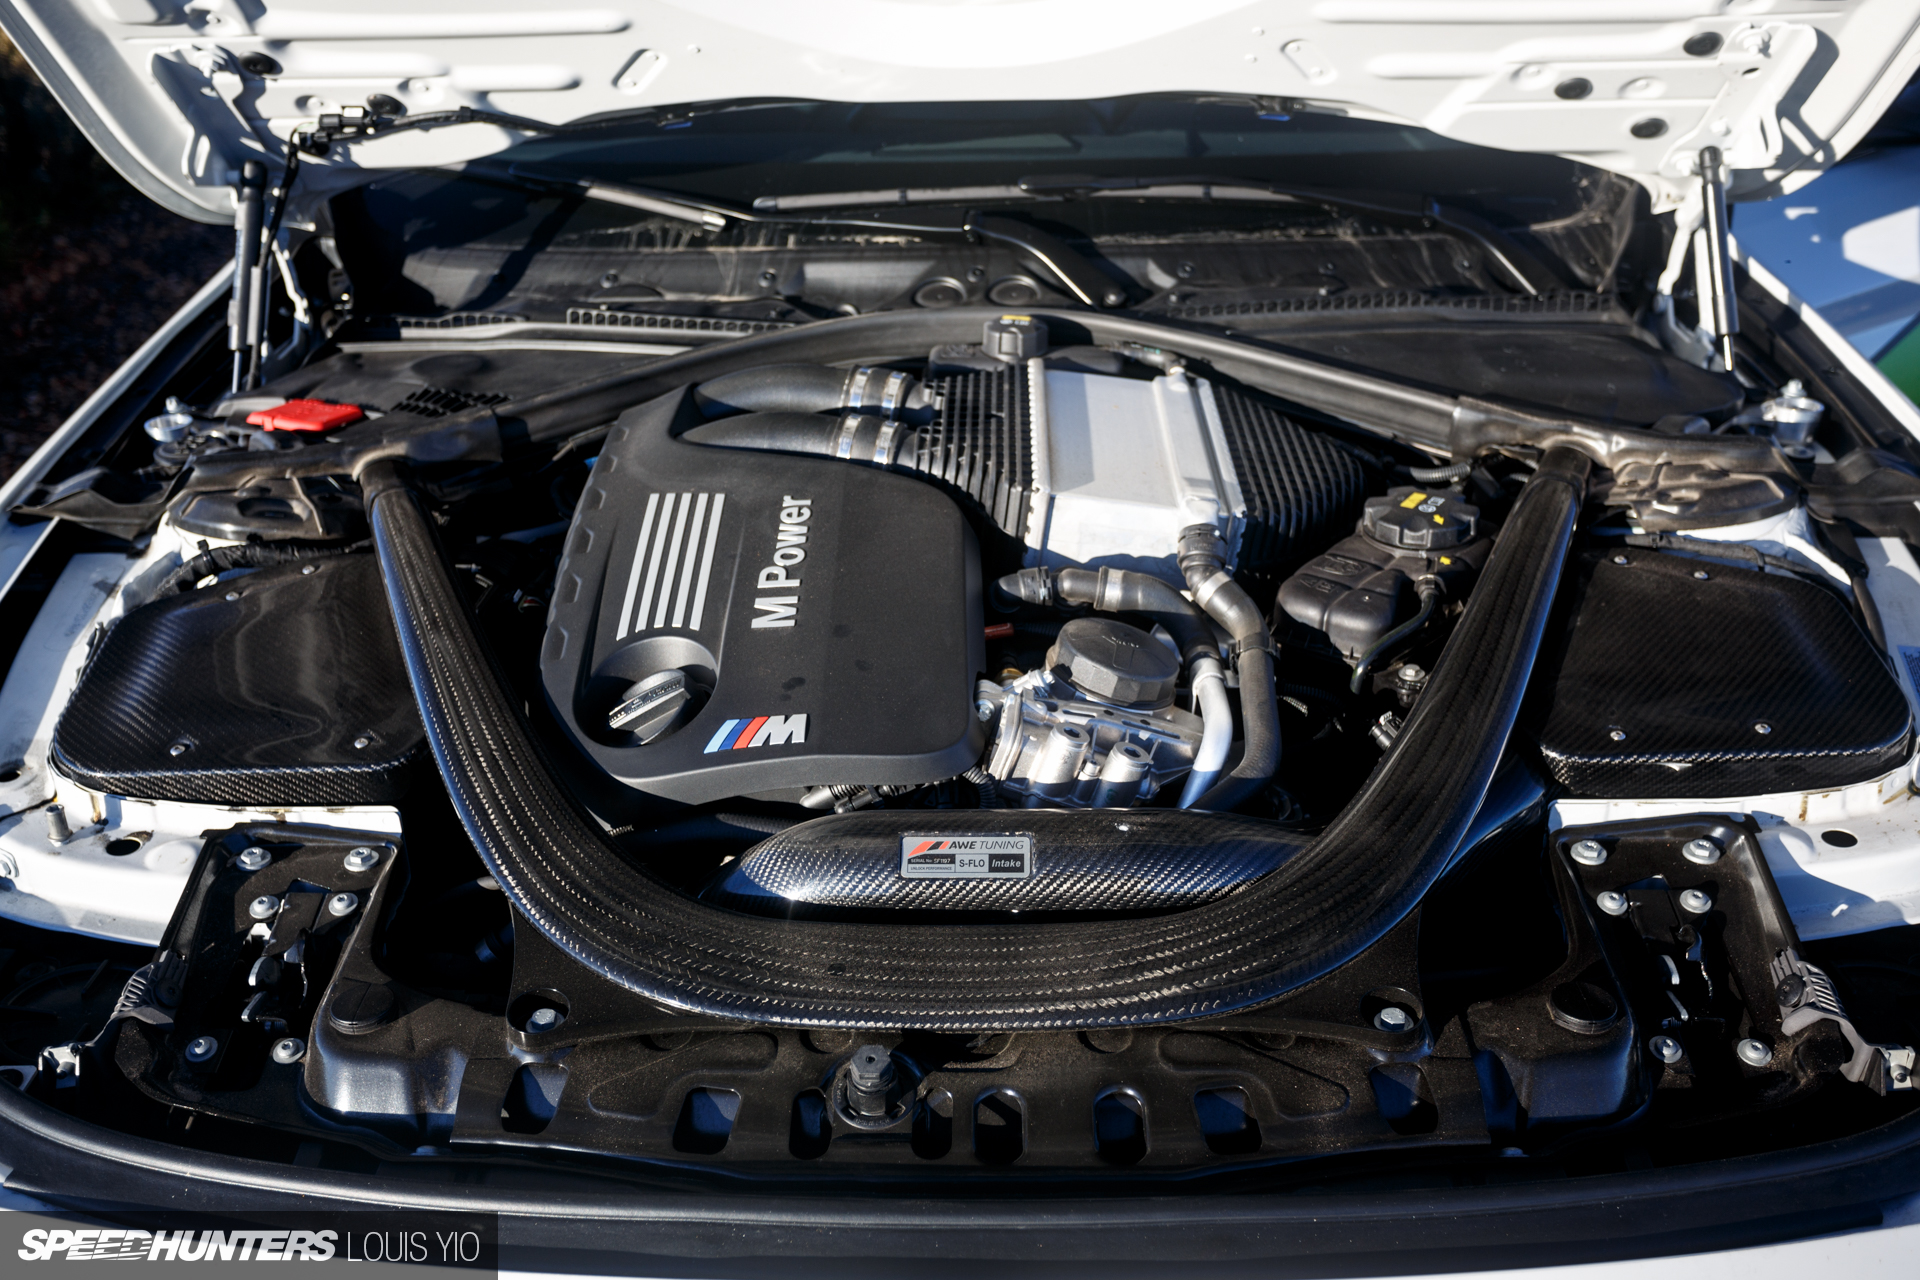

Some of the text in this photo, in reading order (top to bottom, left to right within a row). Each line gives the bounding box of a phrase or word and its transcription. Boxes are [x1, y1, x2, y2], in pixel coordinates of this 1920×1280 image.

[751, 495, 812, 629] M Power
[747, 713, 808, 748] M
[949, 841, 1025, 850] AWE TUNING
[959, 859, 986, 868] S-FLO
[991, 859, 1022, 868] Intake
